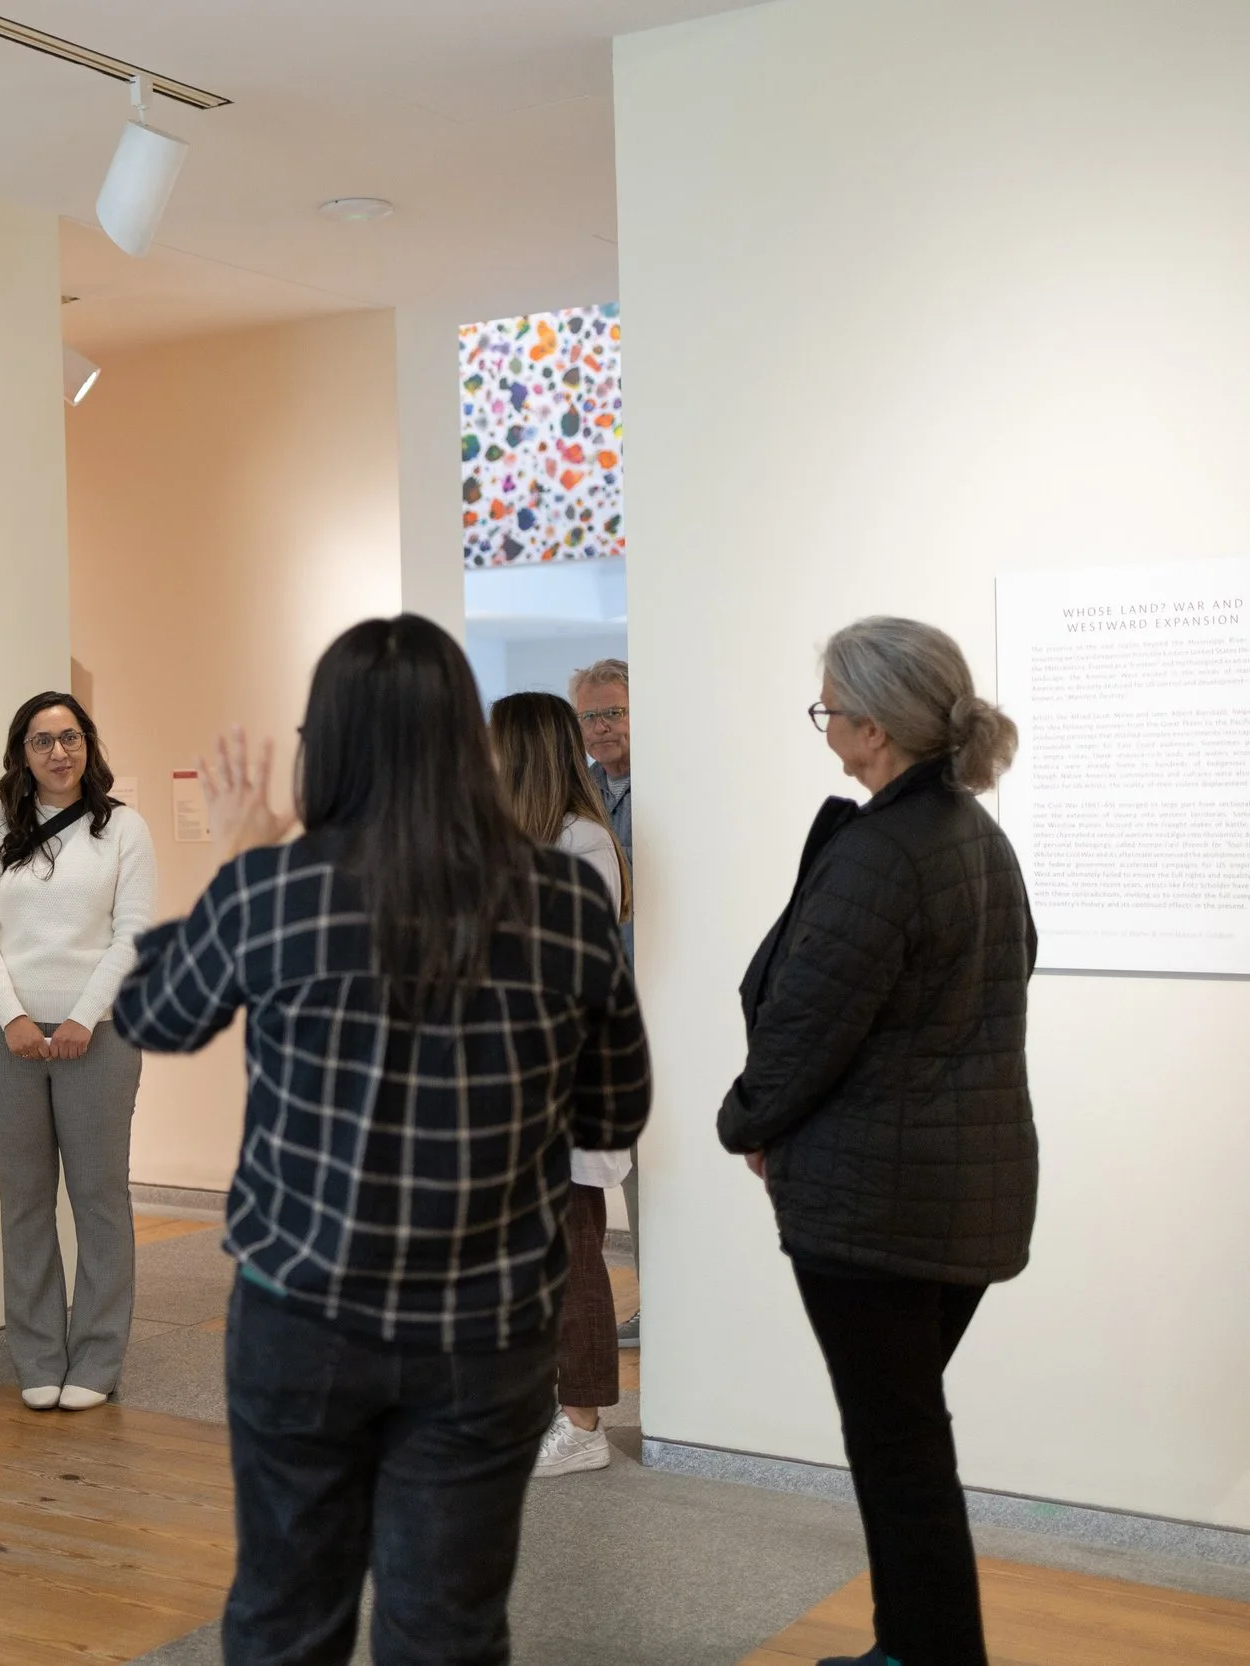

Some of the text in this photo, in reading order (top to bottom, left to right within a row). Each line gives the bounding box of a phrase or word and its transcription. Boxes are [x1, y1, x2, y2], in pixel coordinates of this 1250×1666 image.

[1062, 598, 1244, 617] WHOSE LAND? WAR AND
[1067, 614, 1239, 632] WESTWARD EXPANSION
